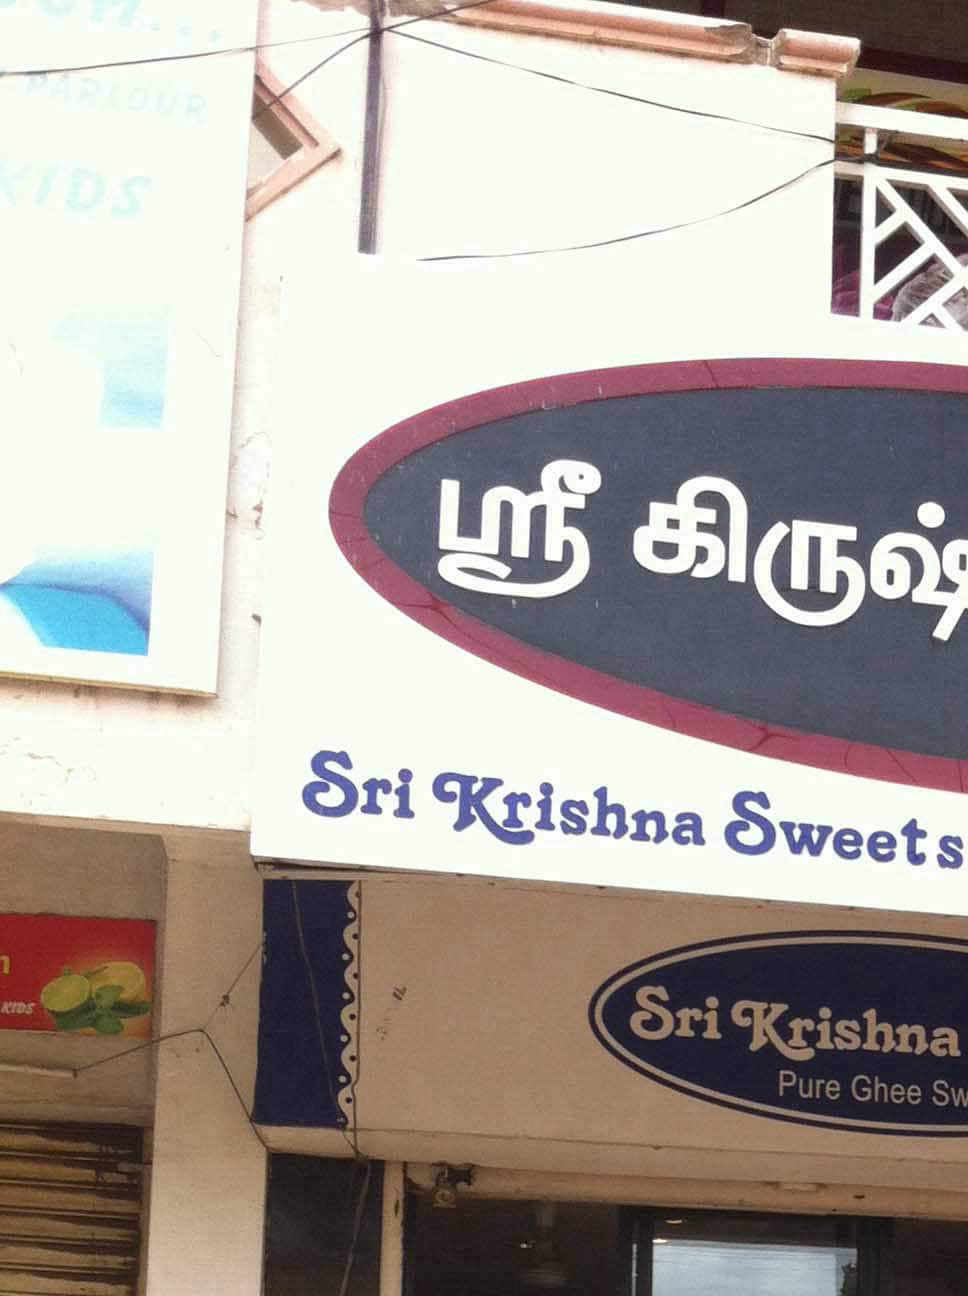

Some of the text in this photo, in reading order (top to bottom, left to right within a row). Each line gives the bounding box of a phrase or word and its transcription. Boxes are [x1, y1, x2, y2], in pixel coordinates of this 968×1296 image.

[301, 749, 965, 870] Sri Krishna Sweets
[629, 985, 722, 1041] Sri
[730, 999, 961, 1062] Krishna
[778, 1069, 841, 1100] Pure
[851, 1074, 922, 1106] Ghee
